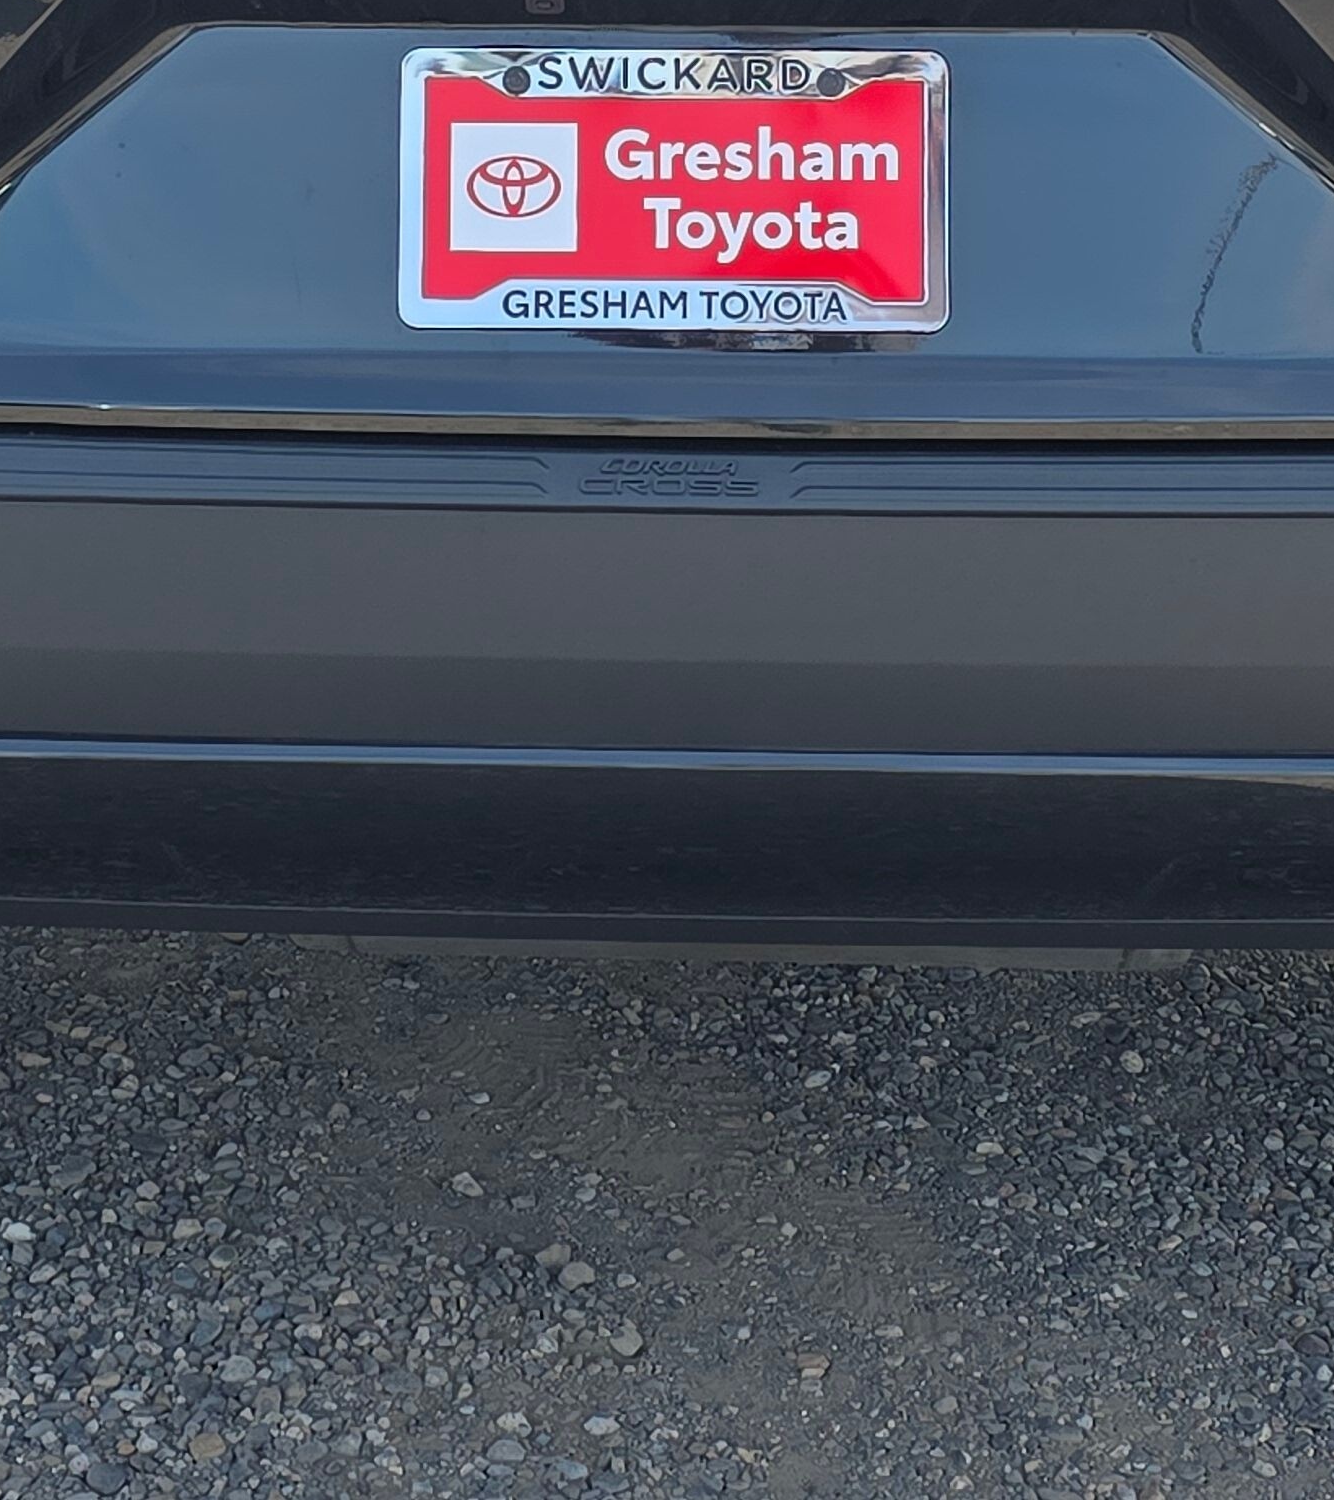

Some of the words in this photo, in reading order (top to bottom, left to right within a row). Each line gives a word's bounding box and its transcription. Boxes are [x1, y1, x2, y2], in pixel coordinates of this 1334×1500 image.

[537, 56, 811, 93] SWICKARD
[603, 125, 900, 182] Gresham
[643, 196, 859, 265] Toyota
[501, 288, 688, 321] GRESHAM
[699, 290, 848, 322] TOYOTA
[599, 458, 739, 477] COROLLA
[579, 477, 760, 497] CROSS
